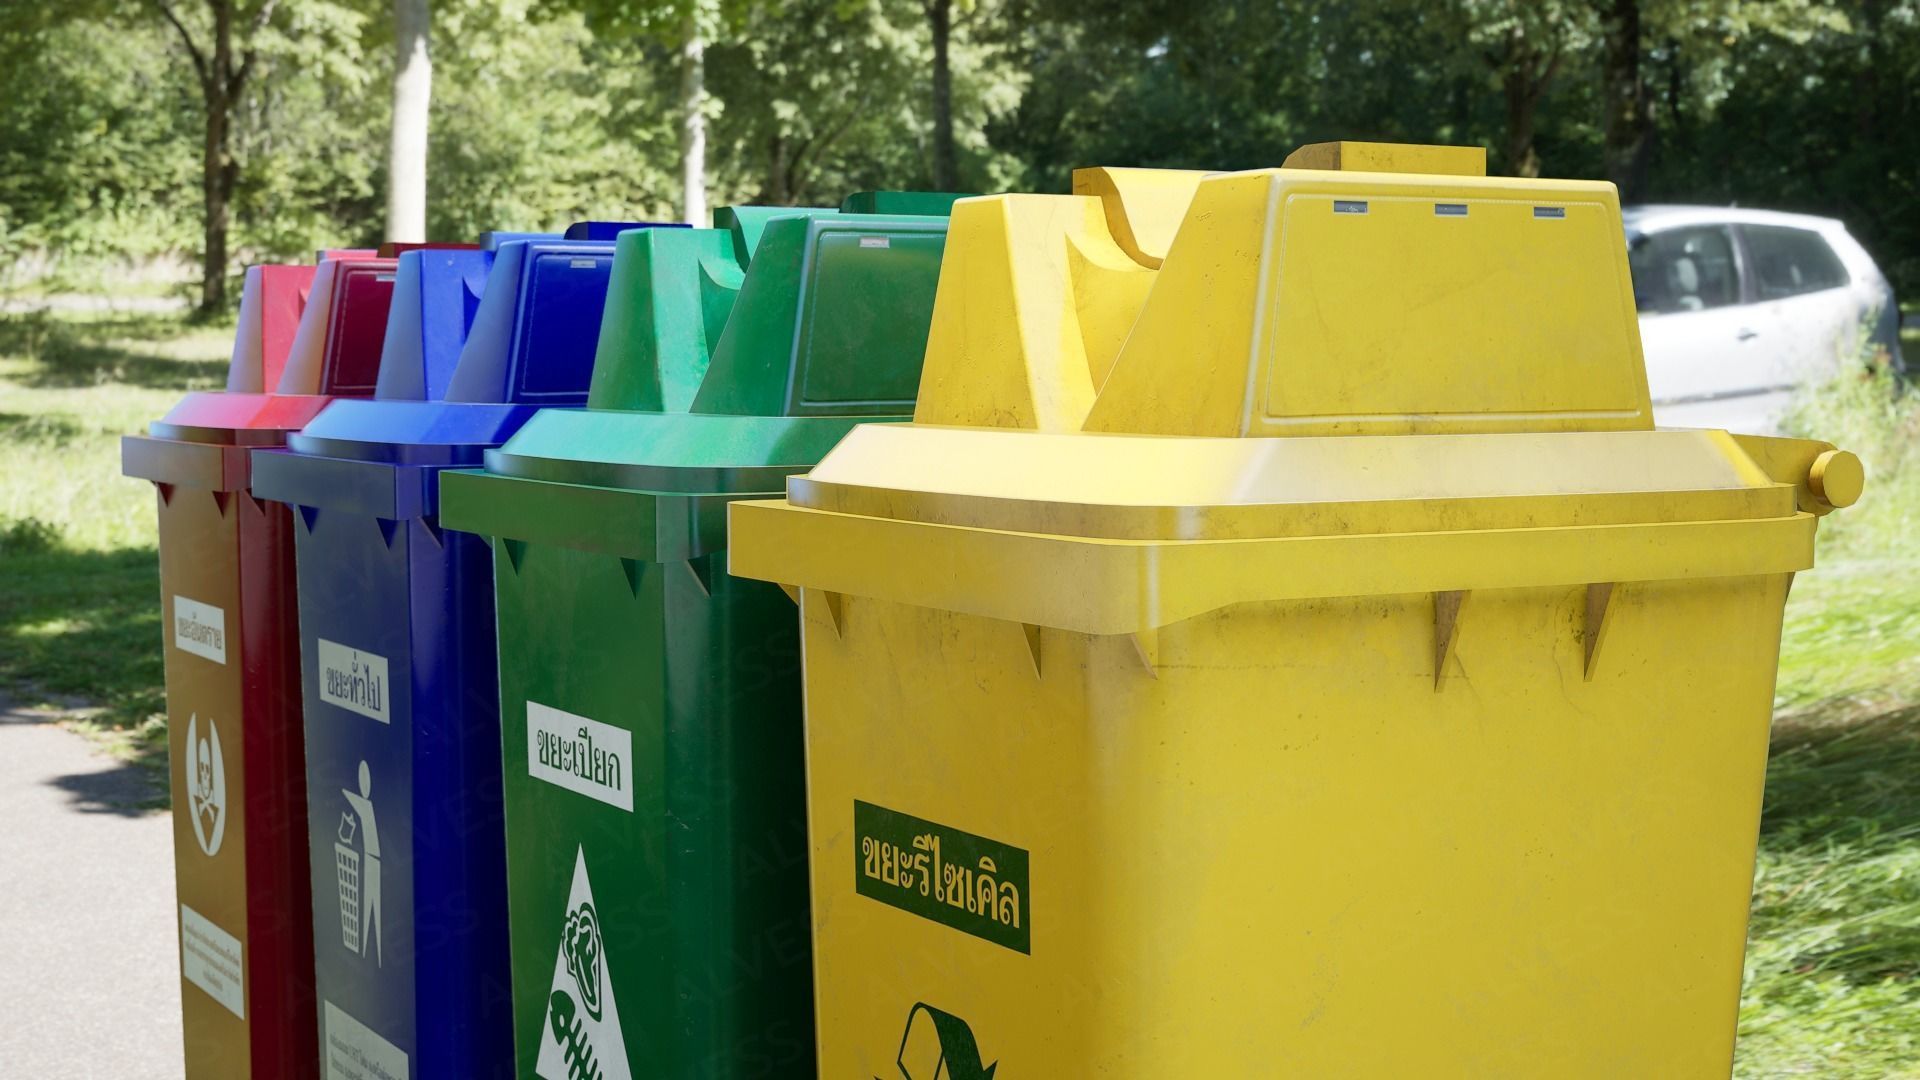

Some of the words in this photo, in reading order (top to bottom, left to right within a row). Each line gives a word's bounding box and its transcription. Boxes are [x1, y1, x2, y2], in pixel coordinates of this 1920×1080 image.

[327, 651, 381, 711] ขยะทั่วไป
[537, 726, 621, 791] ขยะเปียก
[862, 833, 1020, 929] ขยะรีไซเคิล
